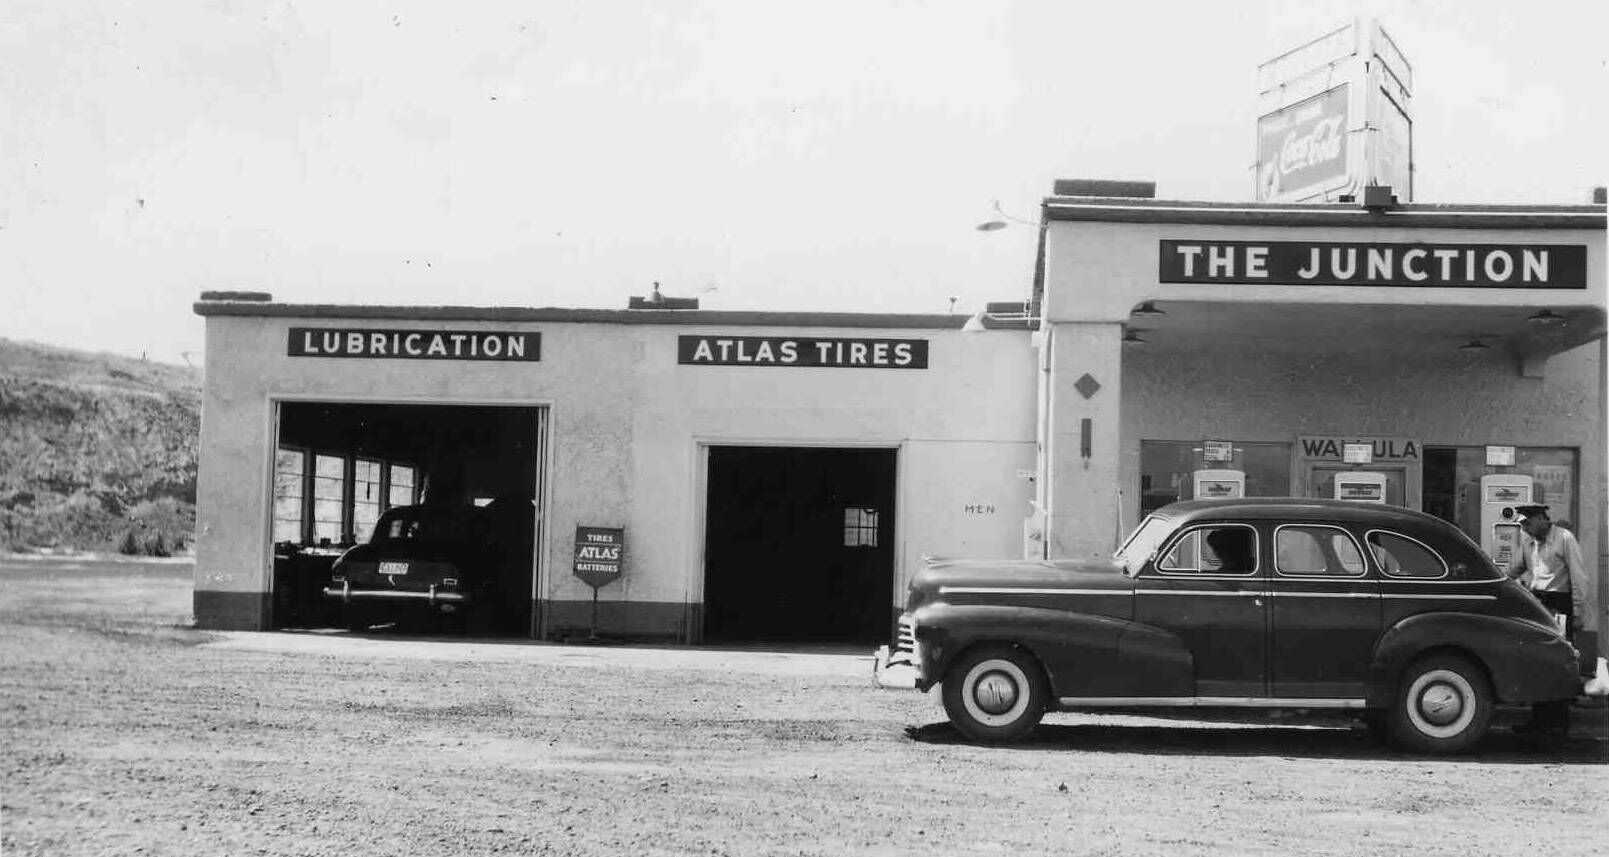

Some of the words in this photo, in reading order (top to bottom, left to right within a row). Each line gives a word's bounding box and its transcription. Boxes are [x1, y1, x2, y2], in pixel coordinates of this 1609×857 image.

[1177, 245, 1269, 278] THE
[1298, 248, 1549, 283] JUNCTION
[304, 331, 525, 357] LUBRICATION
[693, 339, 798, 363] ATLAS
[816, 342, 912, 365] TIRES
[1302, 439, 1418, 459] WAULA
[964, 504, 996, 515] MEN
[586, 534, 613, 542] TIRES
[579, 546, 618, 559] ATLAS
[577, 563, 618, 572] BATTERIES
